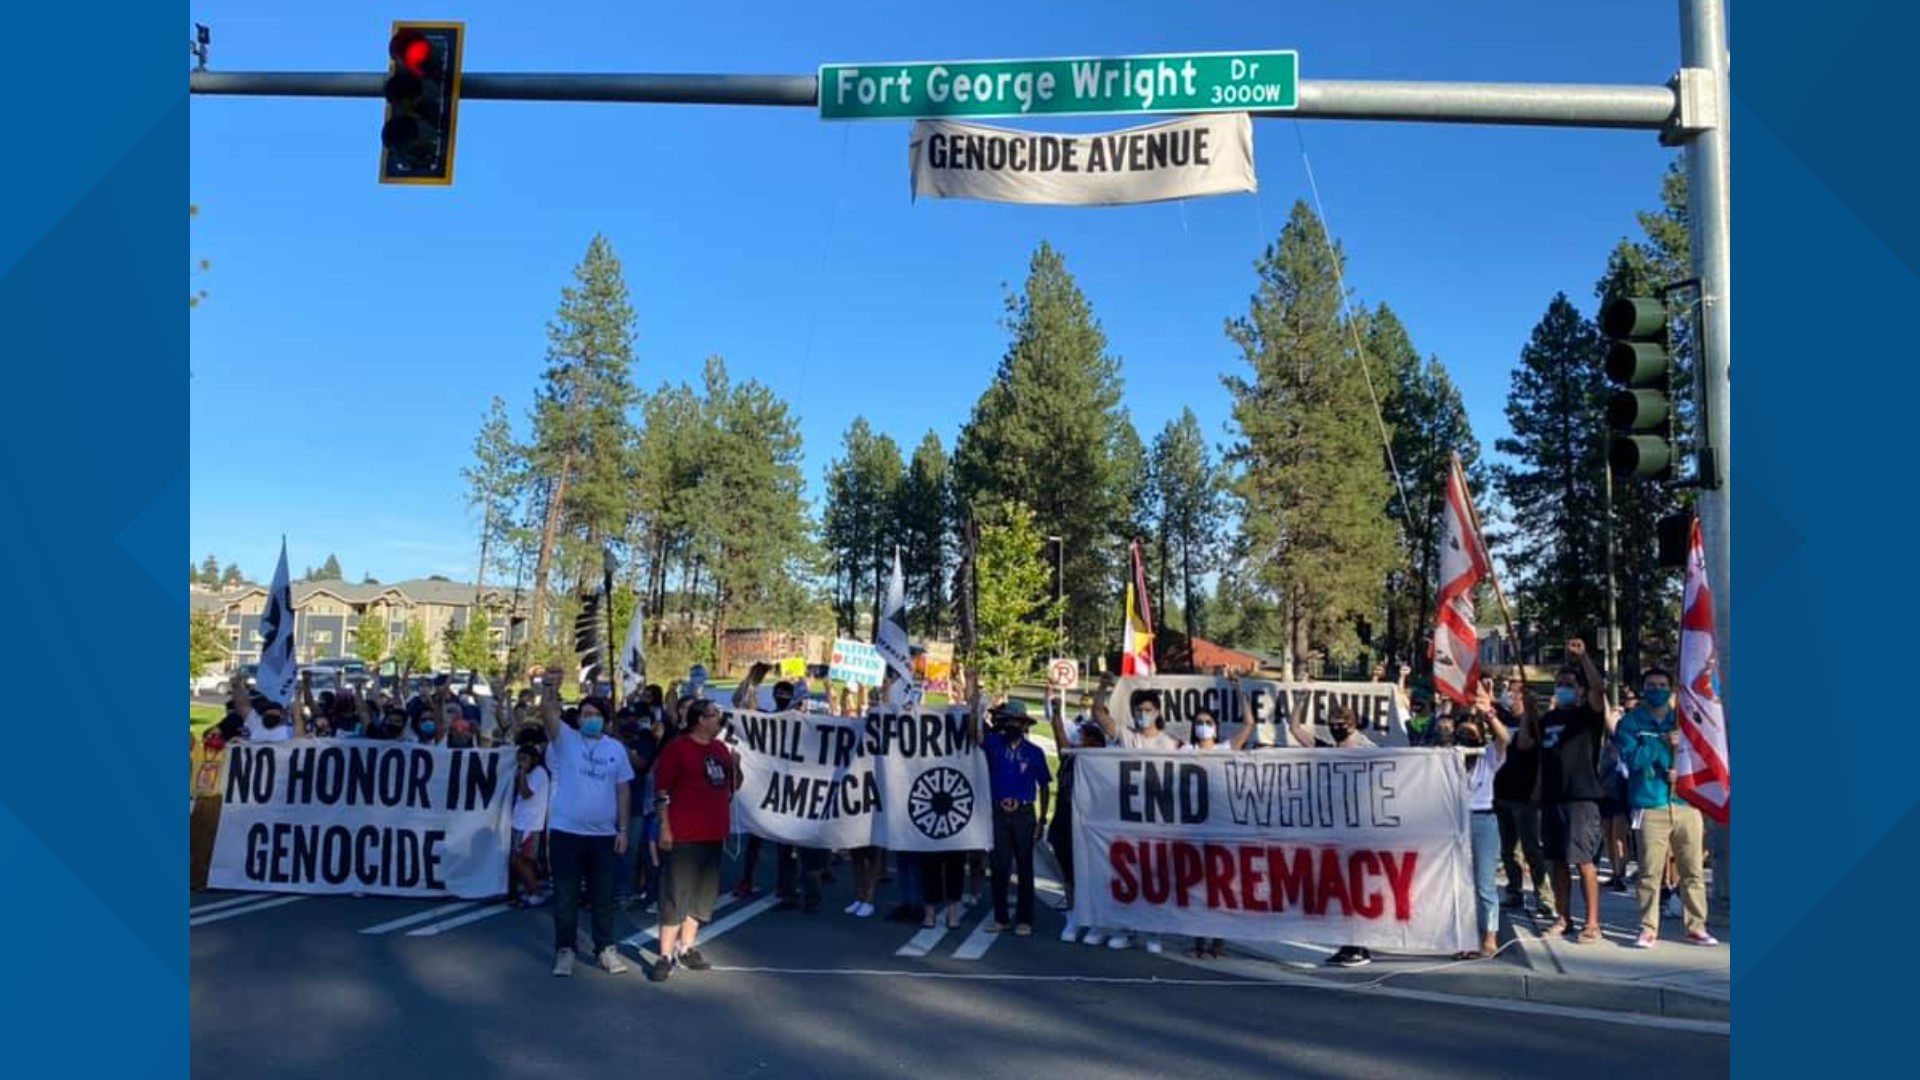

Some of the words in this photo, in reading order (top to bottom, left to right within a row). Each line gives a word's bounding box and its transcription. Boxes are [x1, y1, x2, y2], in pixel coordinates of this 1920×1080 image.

[836, 64, 911, 105] Fort
[926, 66, 1055, 112] George
[1071, 58, 1197, 110] Wright
[1210, 83, 1282, 105] 3000W
[1230, 58, 1260, 80] Dr
[928, 131, 1079, 172] GENOCIDE
[1086, 127, 1210, 172] AVENUE
[1130, 688, 1265, 725] NOCIE
[1274, 690, 1391, 733] AVENUE
[742, 715, 804, 763] WILL
[816, 713, 970, 768] TRSFORM
[225, 746, 276, 804] NO
[286, 747, 434, 810] HONOR
[446, 748, 499, 811] IN
[1118, 760, 1209, 825] END
[1224, 760, 1401, 828] WHITE
[245, 823, 447, 890] GENOCIDE
[1109, 840, 1419, 921] SUPREMACY
